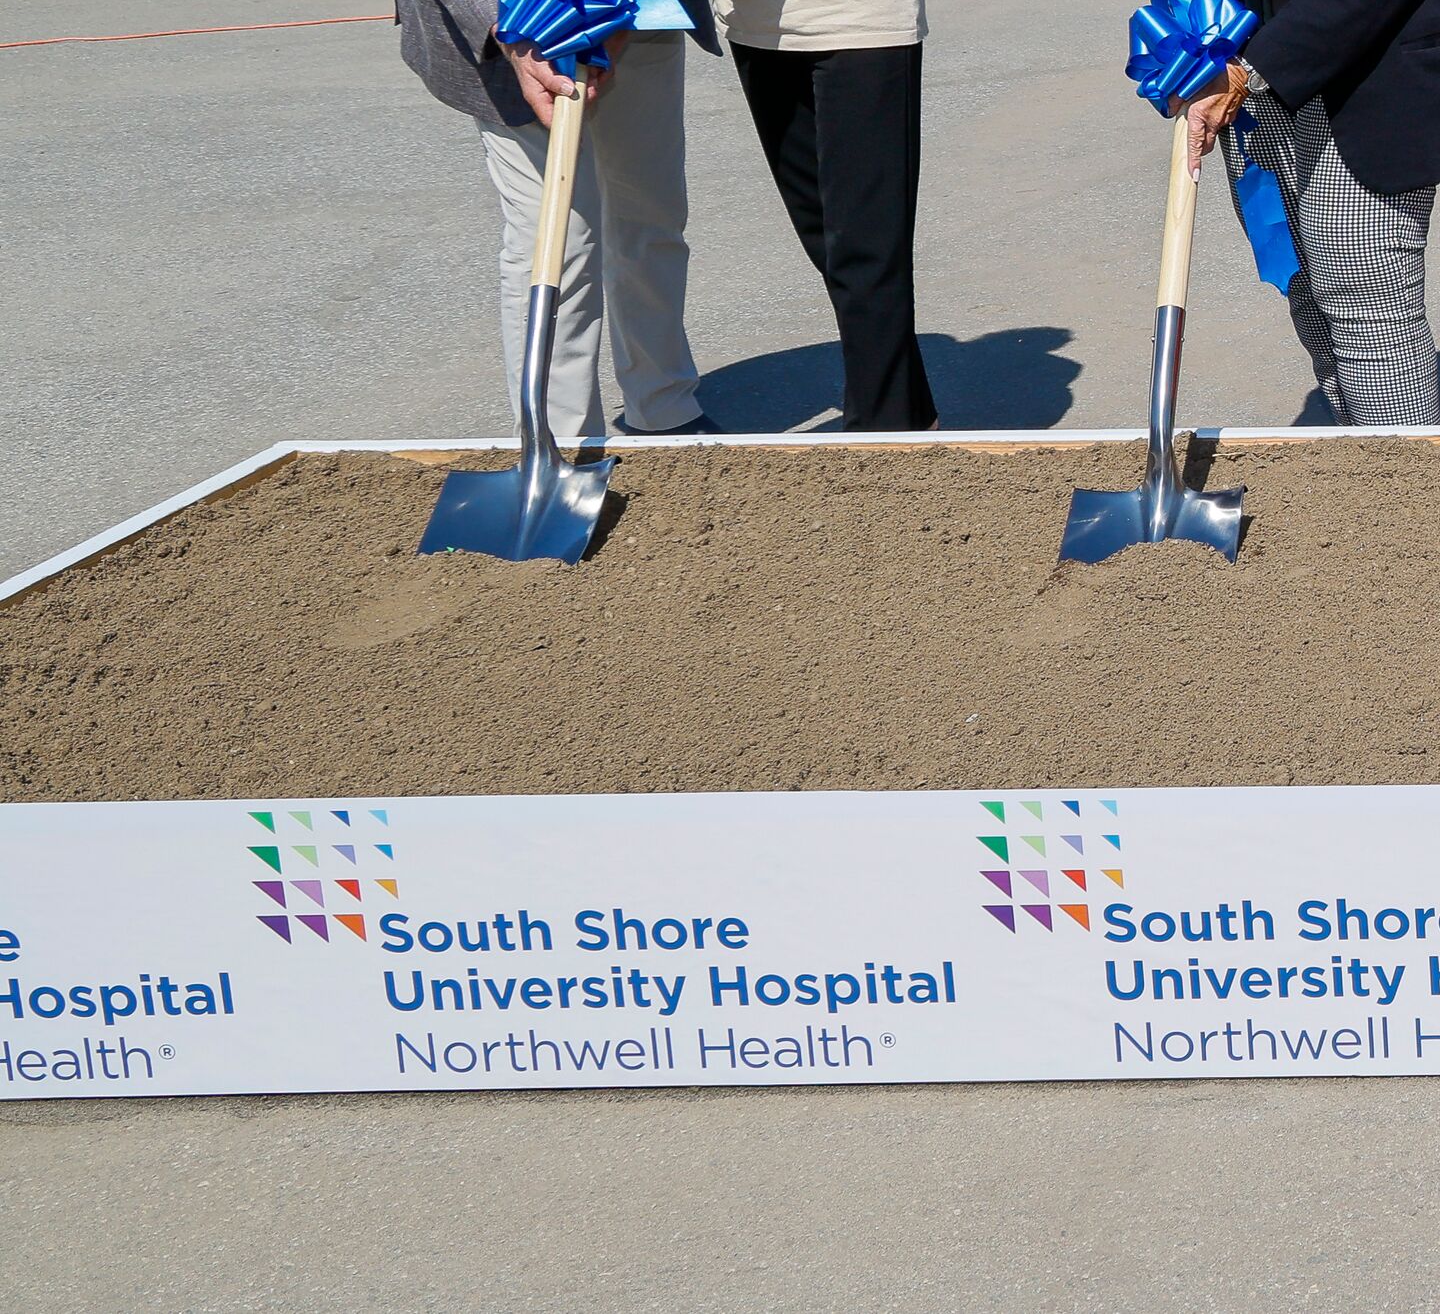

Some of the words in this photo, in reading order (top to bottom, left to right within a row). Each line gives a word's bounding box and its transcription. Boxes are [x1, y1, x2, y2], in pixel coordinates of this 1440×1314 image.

[379, 910, 552, 953] South
[575, 909, 749, 951] Shore
[1104, 900, 1274, 943] South
[384, 966, 686, 1016] University
[709, 961, 955, 1013] Hospital
[1105, 956, 1406, 1005] University
[396, 1028, 673, 1073] Northwell
[1115, 1017, 1388, 1062] Northwell
